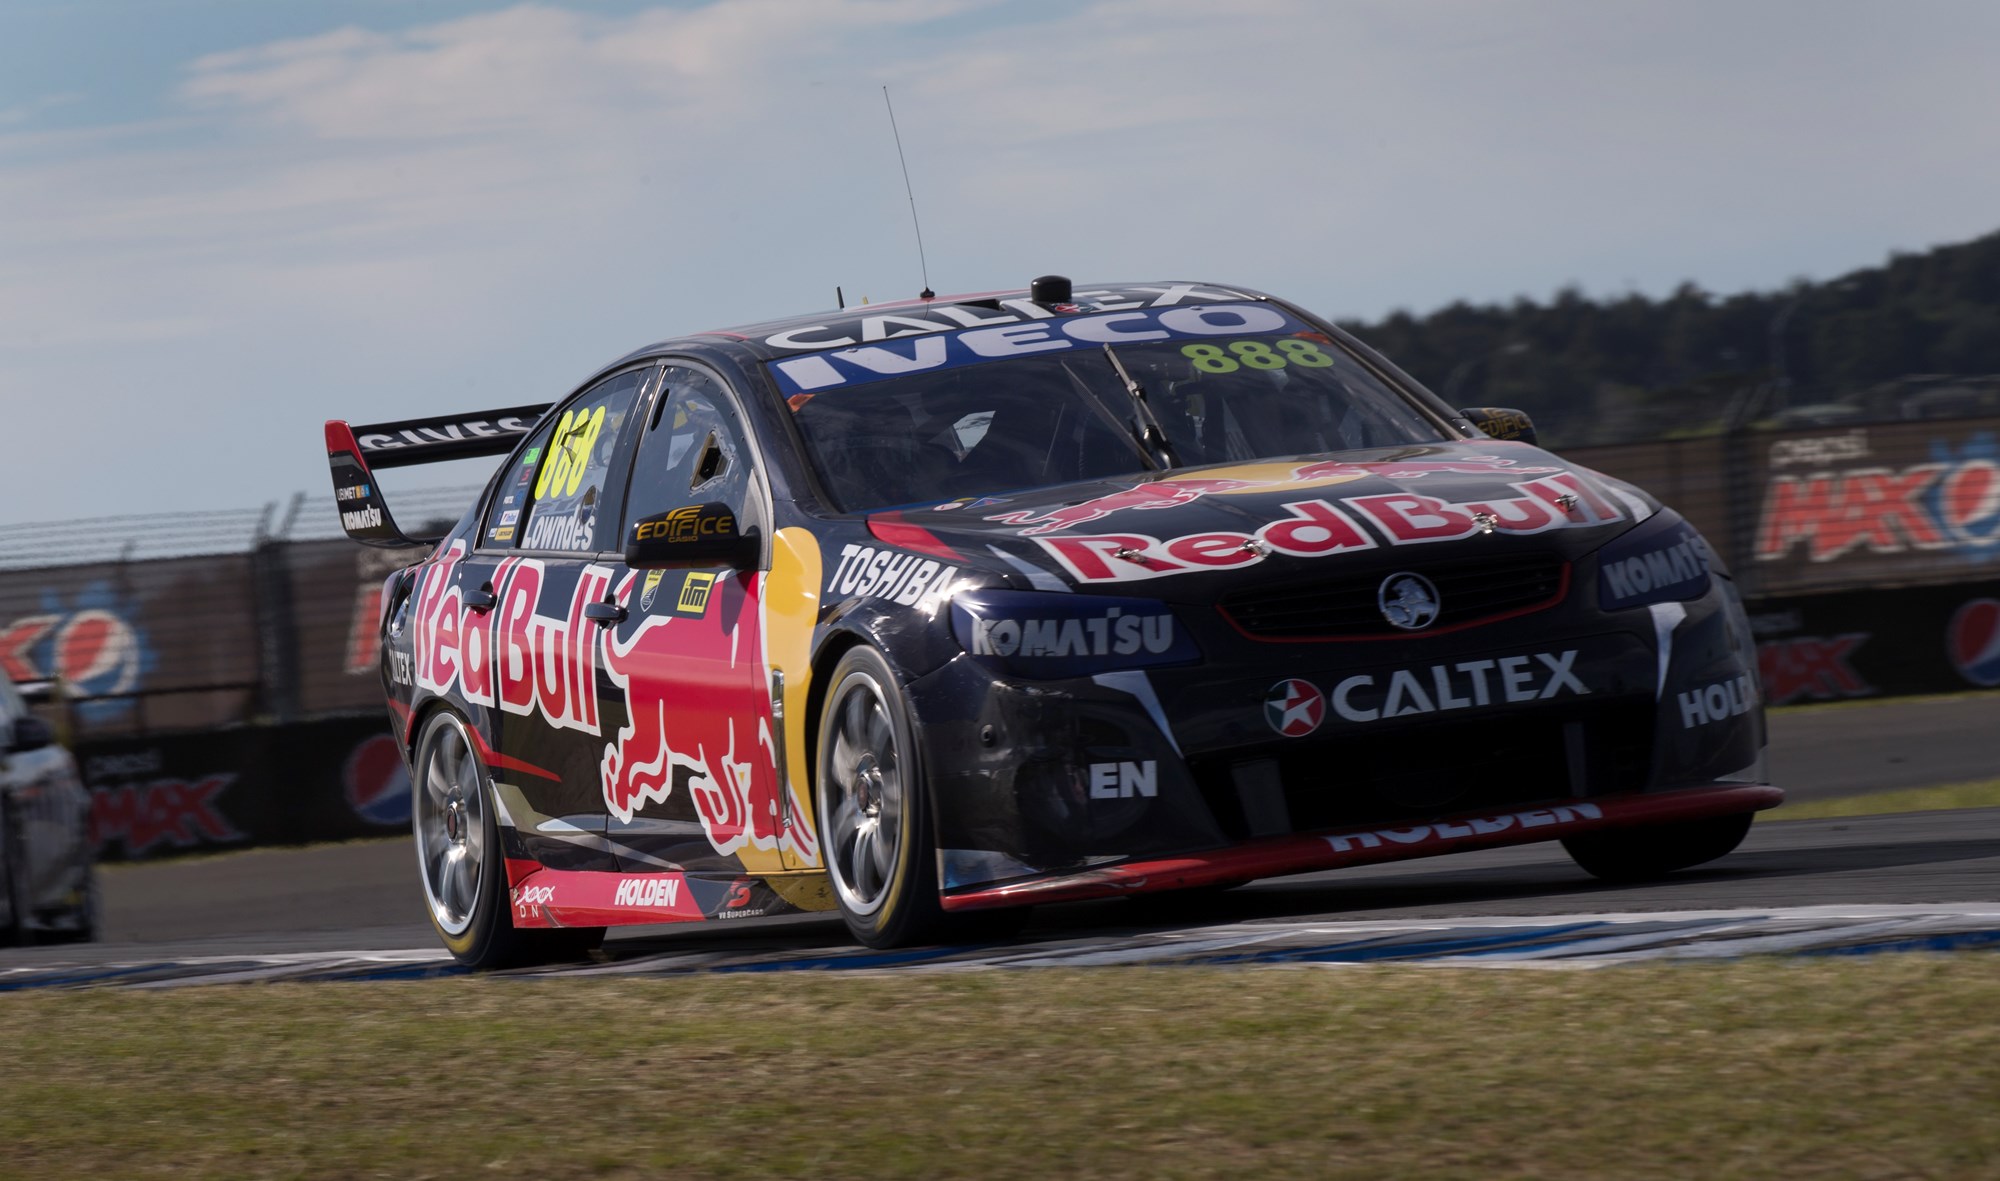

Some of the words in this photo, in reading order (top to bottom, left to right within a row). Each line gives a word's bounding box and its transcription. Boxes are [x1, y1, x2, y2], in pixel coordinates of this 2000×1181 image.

[776, 302, 1287, 390] IVECO
[1180, 339, 1334, 373] 888
[343, 503, 382, 531] KOMATSU
[521, 503, 596, 550] Lowndes
[636, 515, 732, 540] EDIFICE
[1030, 498, 1378, 583] Red
[1340, 471, 1626, 546] Bull
[827, 543, 958, 613] TOSHIBA
[1602, 531, 1710, 599] KOMATS
[971, 607, 1174, 657] KOMATSU
[1332, 649, 1592, 722] CALTEX
[1088, 760, 1159, 799] EN
[1321, 802, 1604, 853] HOLDEN
[614, 878, 680, 907] HOLDEN
